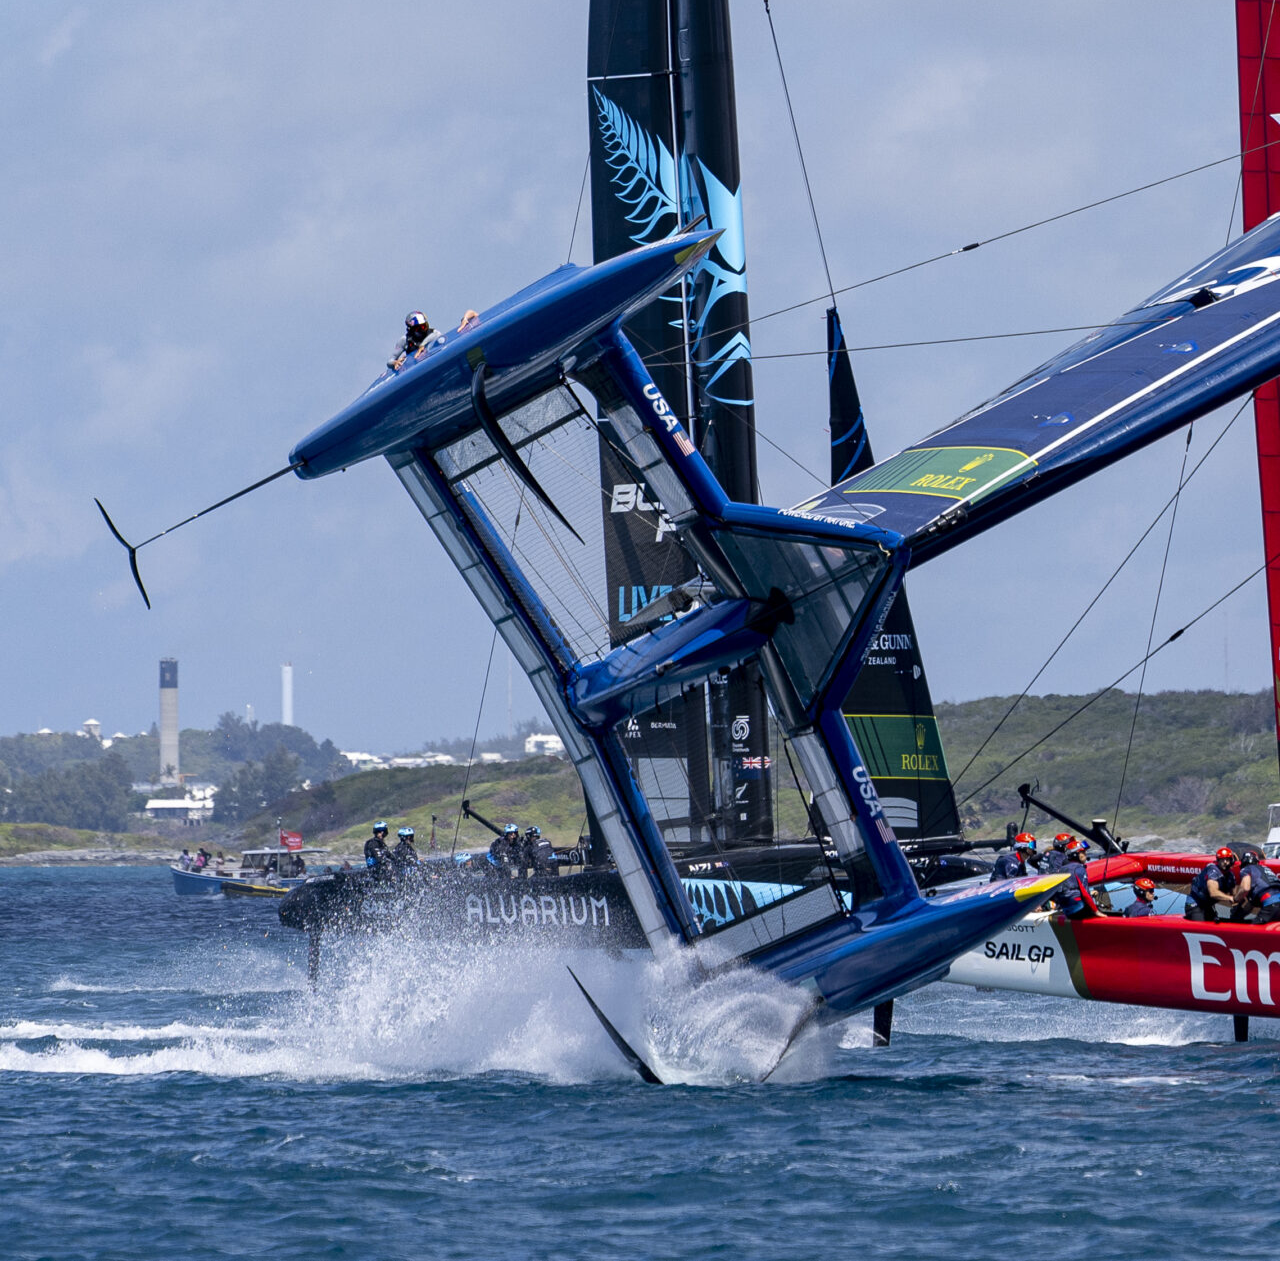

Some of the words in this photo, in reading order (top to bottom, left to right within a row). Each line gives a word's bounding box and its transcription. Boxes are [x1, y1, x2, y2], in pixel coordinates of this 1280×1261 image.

[642, 382, 679, 432] USA
[910, 474, 977, 491] ROLEX
[868, 657, 897, 665] ZEALAND
[901, 754, 939, 772] ROLEX
[852, 765, 882, 818] USA
[466, 894, 611, 927] ALVARIUM
